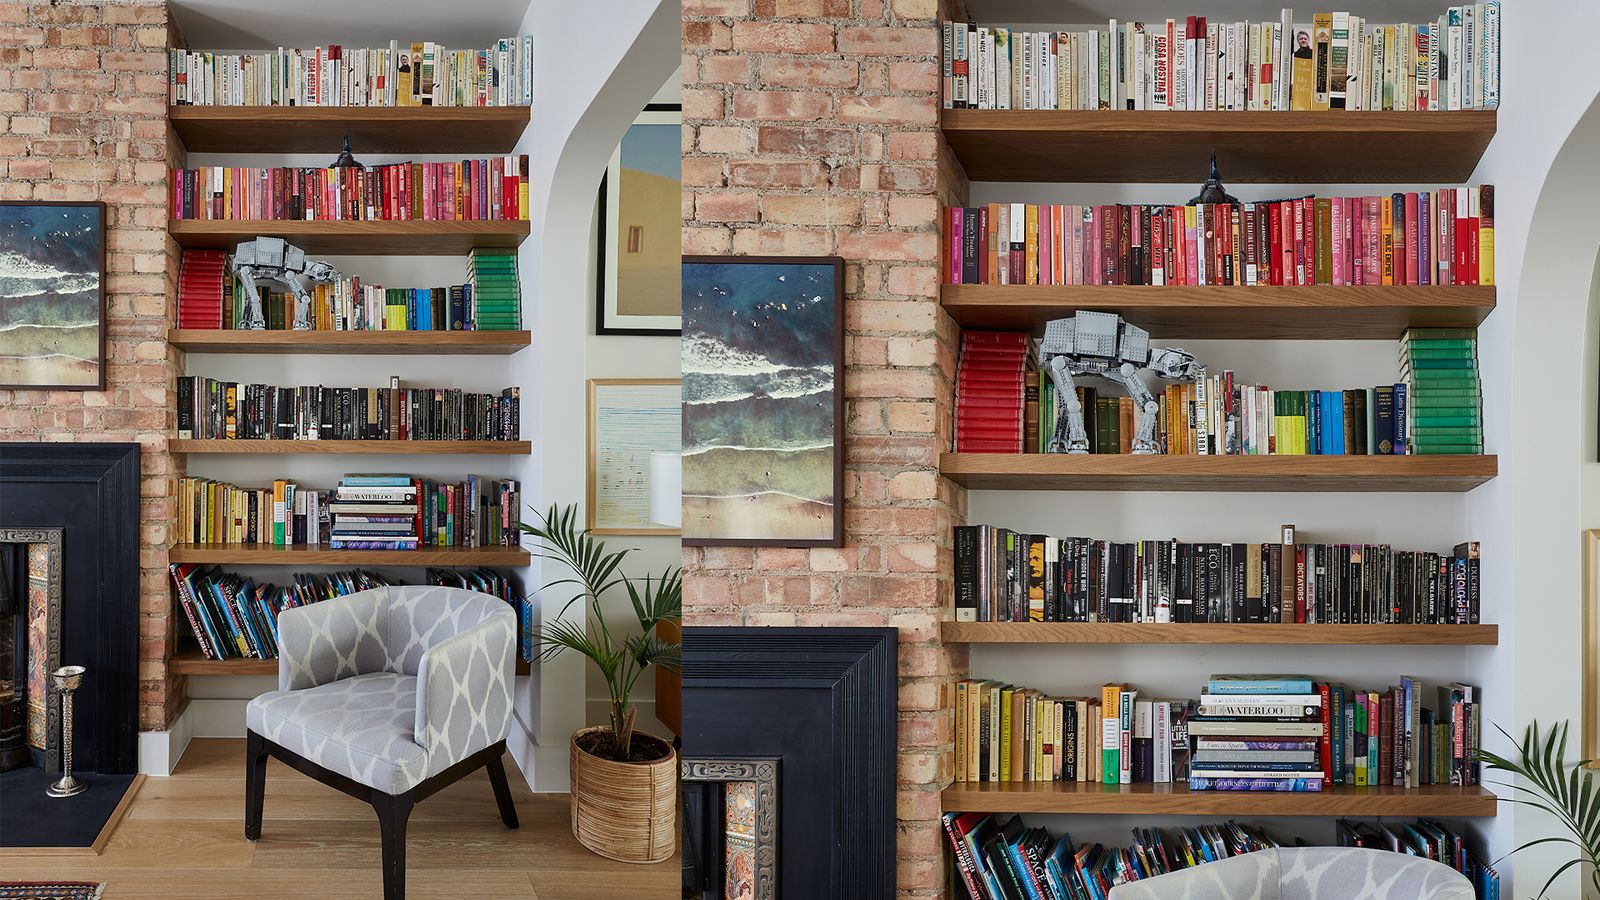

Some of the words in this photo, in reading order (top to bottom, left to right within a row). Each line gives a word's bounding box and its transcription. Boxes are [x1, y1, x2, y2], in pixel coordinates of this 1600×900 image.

[1158, 36, 1167, 59] COSA
[1158, 60, 1167, 93] NOSTRA
[1209, 548, 1218, 569] ECO
[1470, 566, 1478, 599] DUCHESS
[1227, 706, 1283, 715] WATERLOO
[1322, 690, 1330, 710] DEAD
[1171, 732, 1188, 741] LIFE
[1322, 722, 1330, 745] WATER
[1066, 732, 1075, 764] ORIGINS
[1023, 846, 1049, 883] SPACE
